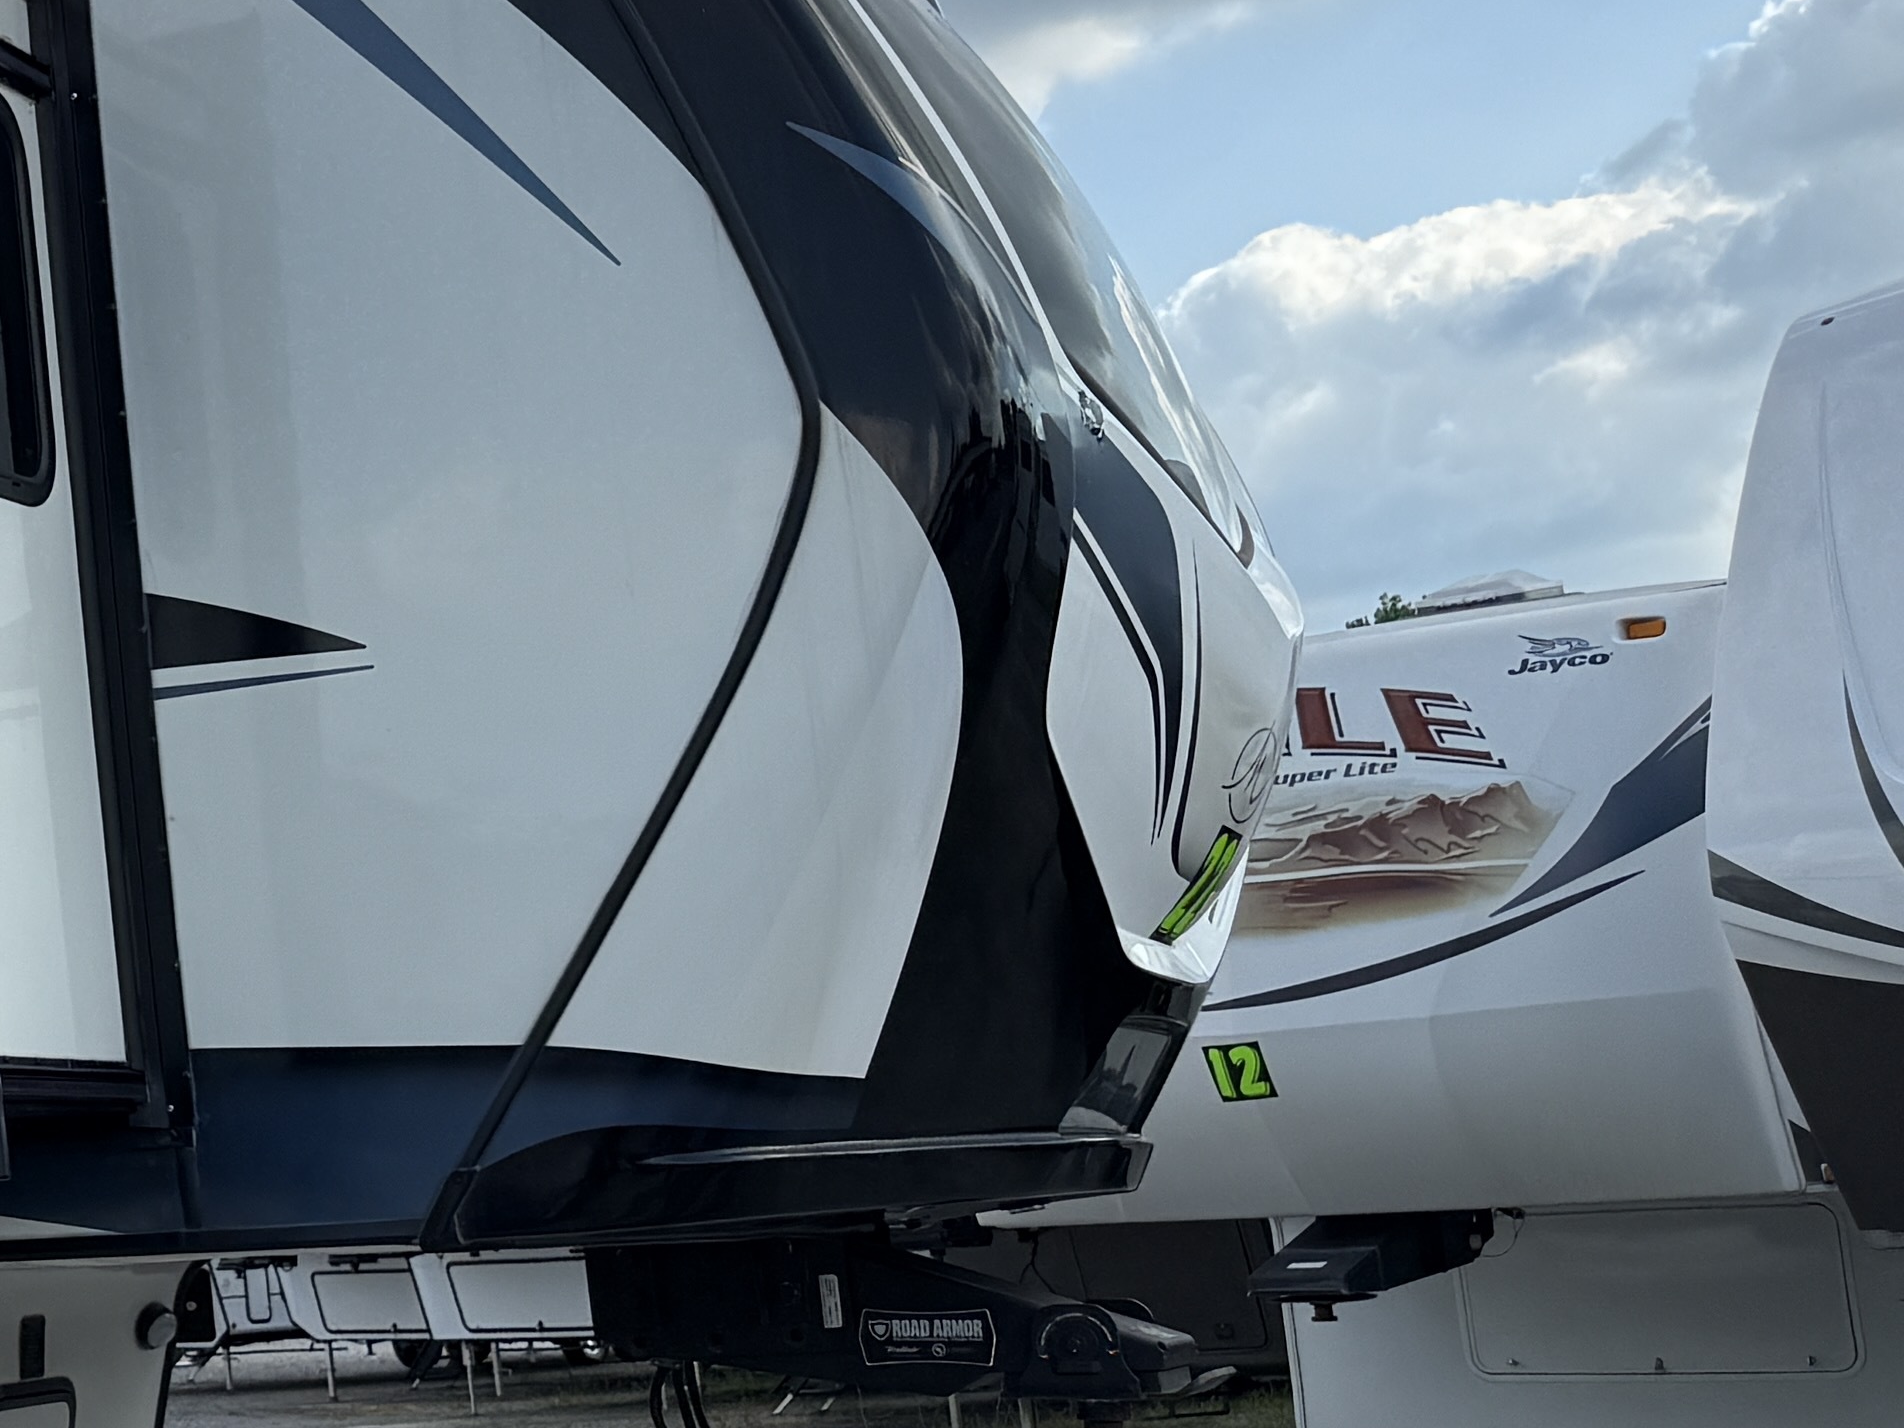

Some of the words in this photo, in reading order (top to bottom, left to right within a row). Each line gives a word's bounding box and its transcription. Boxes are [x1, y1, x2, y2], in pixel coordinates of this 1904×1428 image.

[1507, 653, 1610, 676] Jayco
[1273, 768, 1337, 787] uper
[1343, 761, 1398, 778] Lite
[1208, 1045, 1270, 1099] 12
[891, 1319, 930, 1338] ROAD
[933, 1319, 983, 1338] ARMOR
